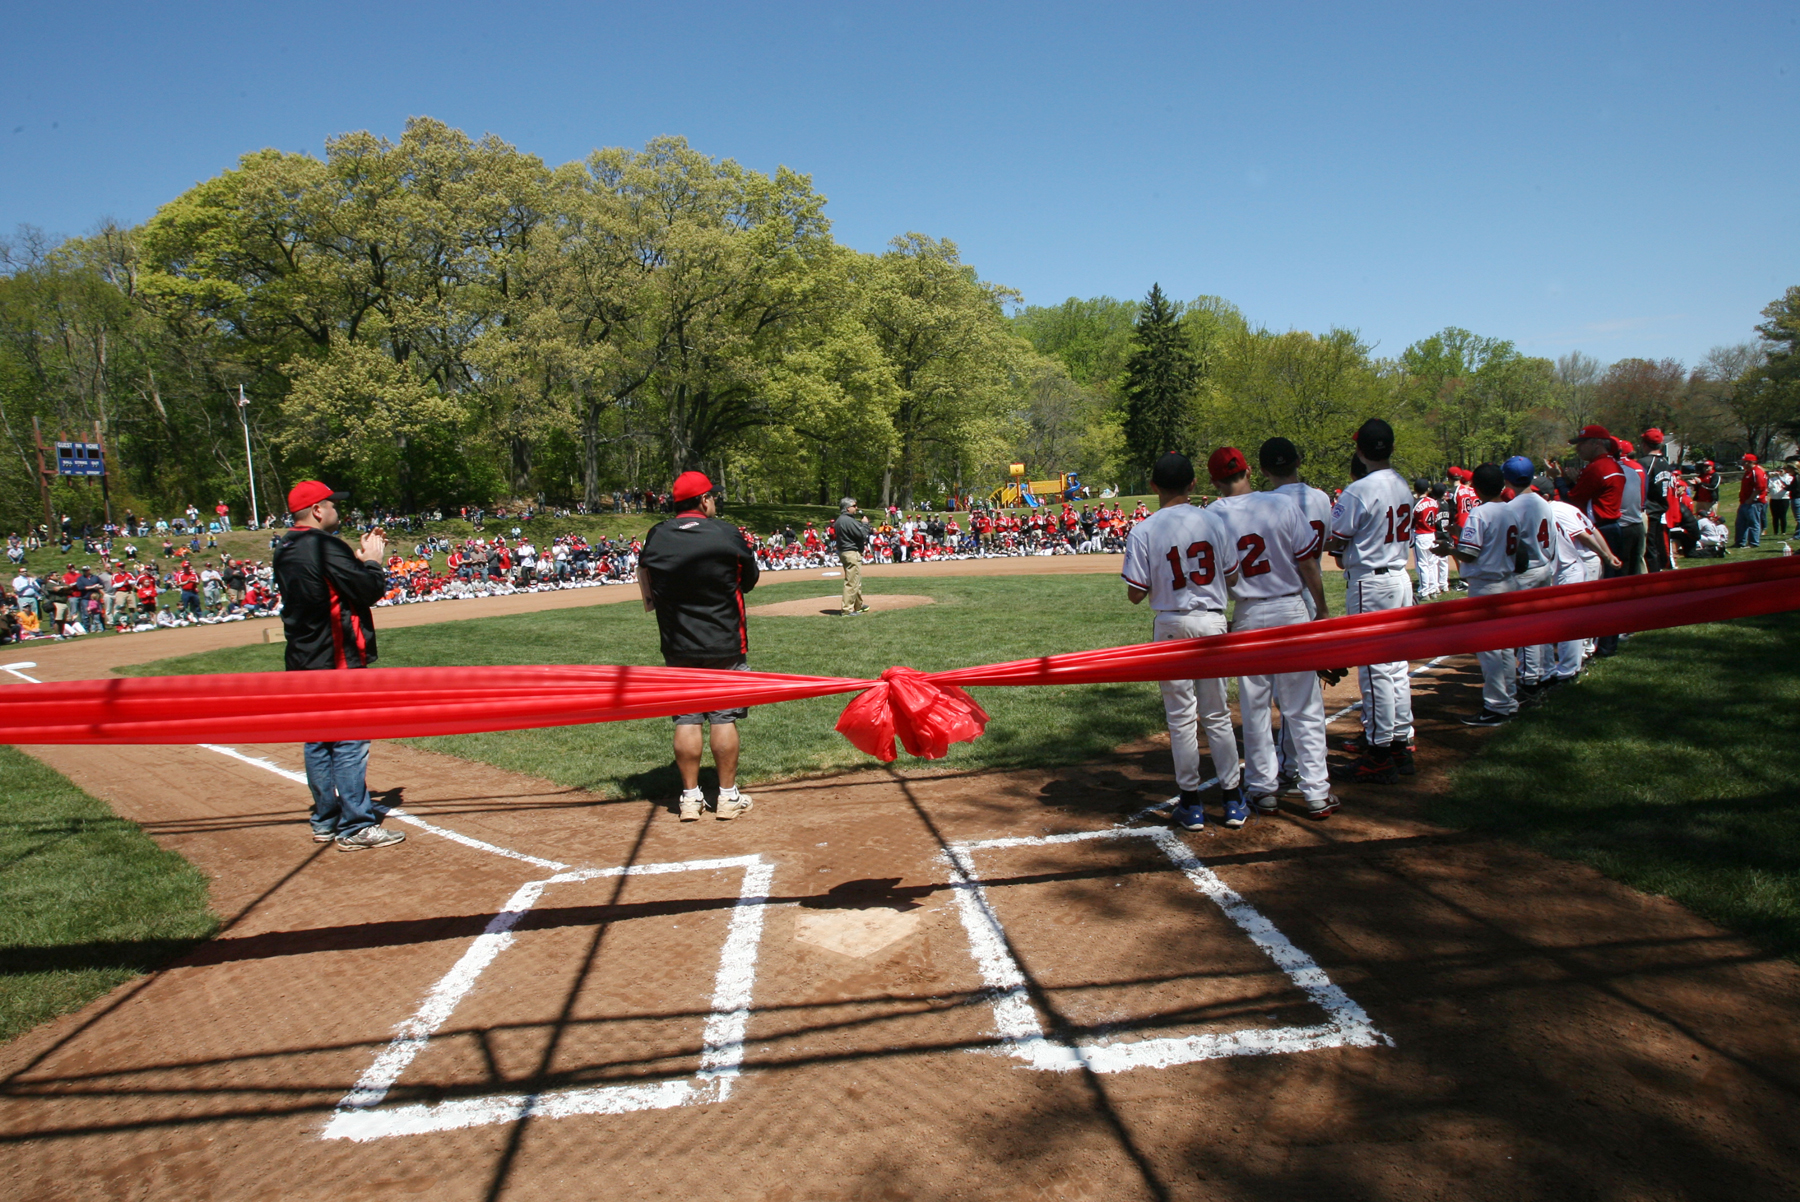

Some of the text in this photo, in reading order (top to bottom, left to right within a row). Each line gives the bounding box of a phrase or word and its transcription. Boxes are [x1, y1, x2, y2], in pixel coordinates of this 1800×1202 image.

[1384, 503, 1411, 544] 12
[1425, 510, 1435, 527] 4
[1536, 518, 1549, 548] 4
[1237, 533, 1271, 578] 2
[1506, 525, 1518, 556] 6
[1166, 540, 1215, 591] 13
